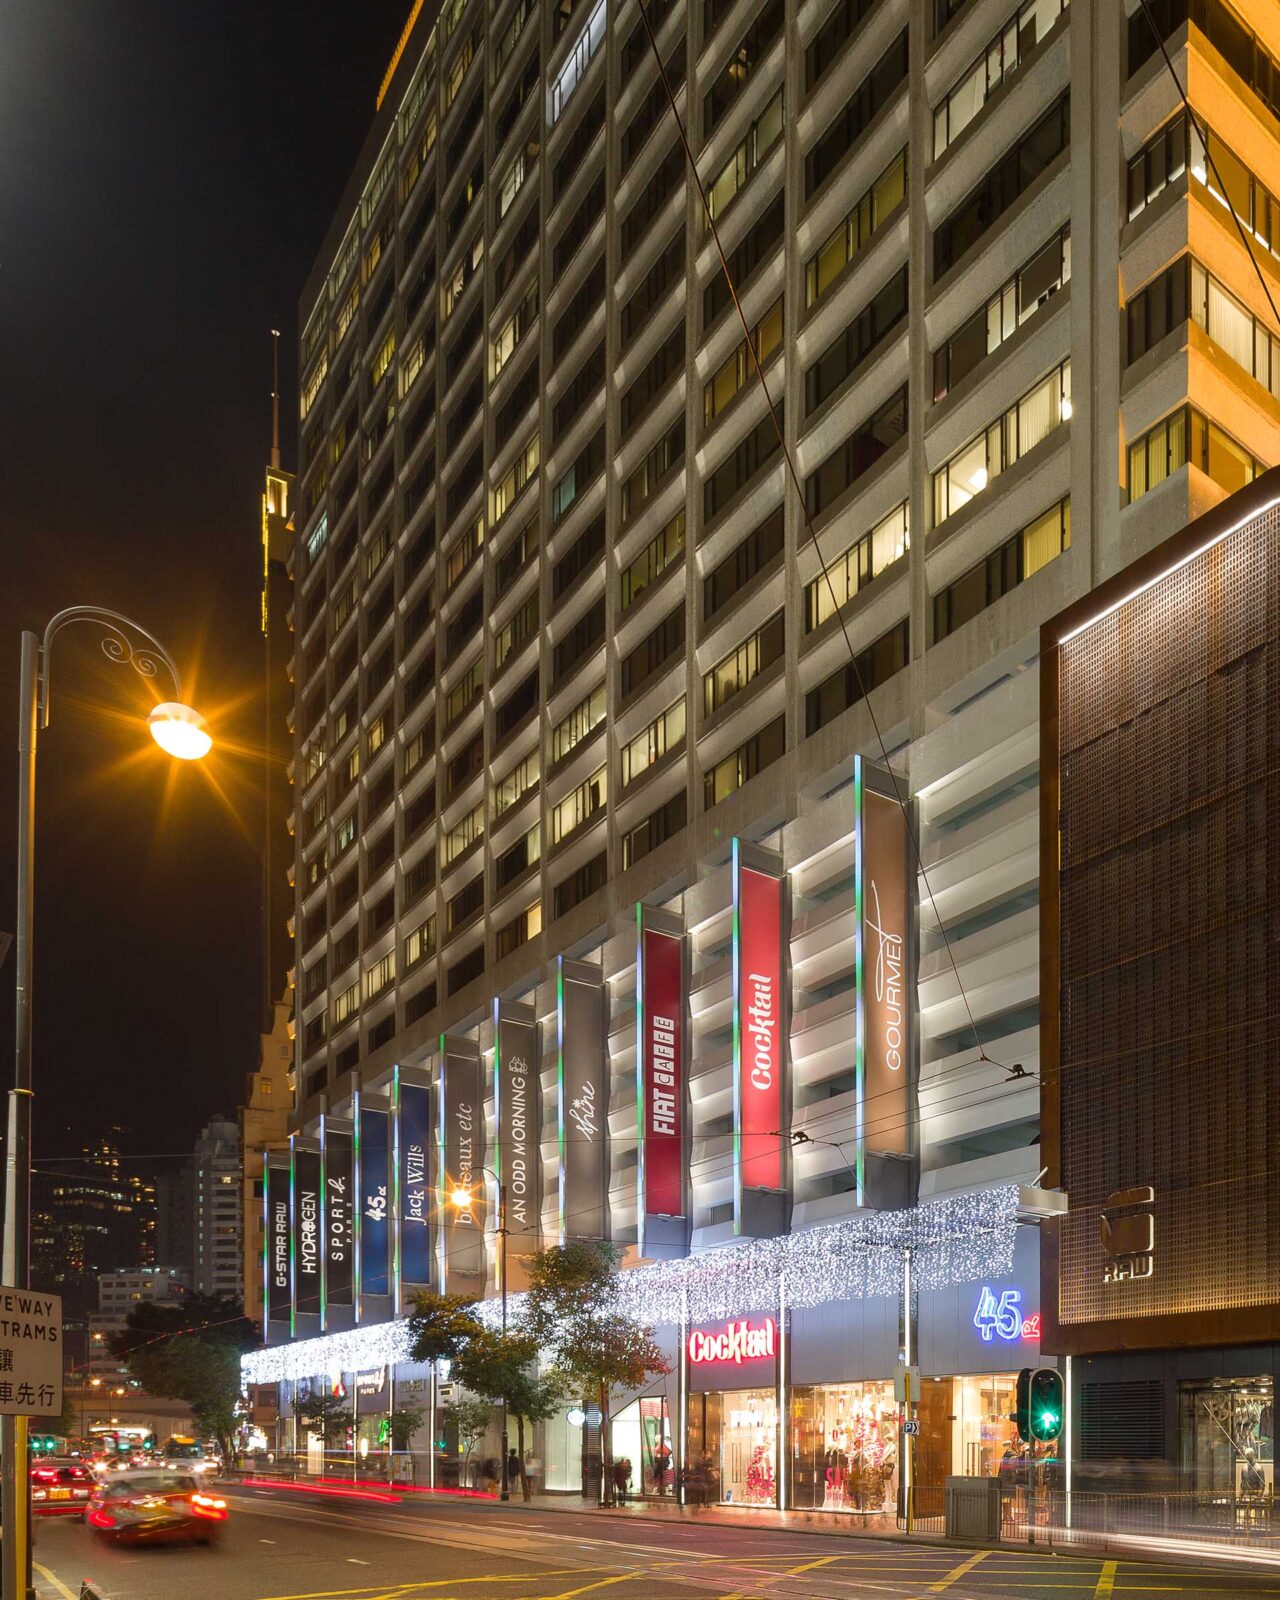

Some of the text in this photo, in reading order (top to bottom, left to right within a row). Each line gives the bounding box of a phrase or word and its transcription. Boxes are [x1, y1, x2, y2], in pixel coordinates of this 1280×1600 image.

[748, 973, 775, 1091] Cocktail
[455, 1102, 473, 1131] etc
[511, 1076, 527, 1156] MORNING
[653, 1088, 675, 1135] FIAT
[404, 1144, 427, 1226] Jack Wills
[512, 1160, 527, 1195] ODD
[276, 1201, 287, 1233] RAW
[331, 1195, 344, 1261] SPORT
[512, 1199, 527, 1224] AN
[1102, 1255, 1154, 1283] RAW
[19, 1298, 53, 1317] WAY
[1, 1321, 58, 1342] TRAMS
[690, 1319, 774, 1364] Cocktail
[825, 1467, 851, 1490] SAL
